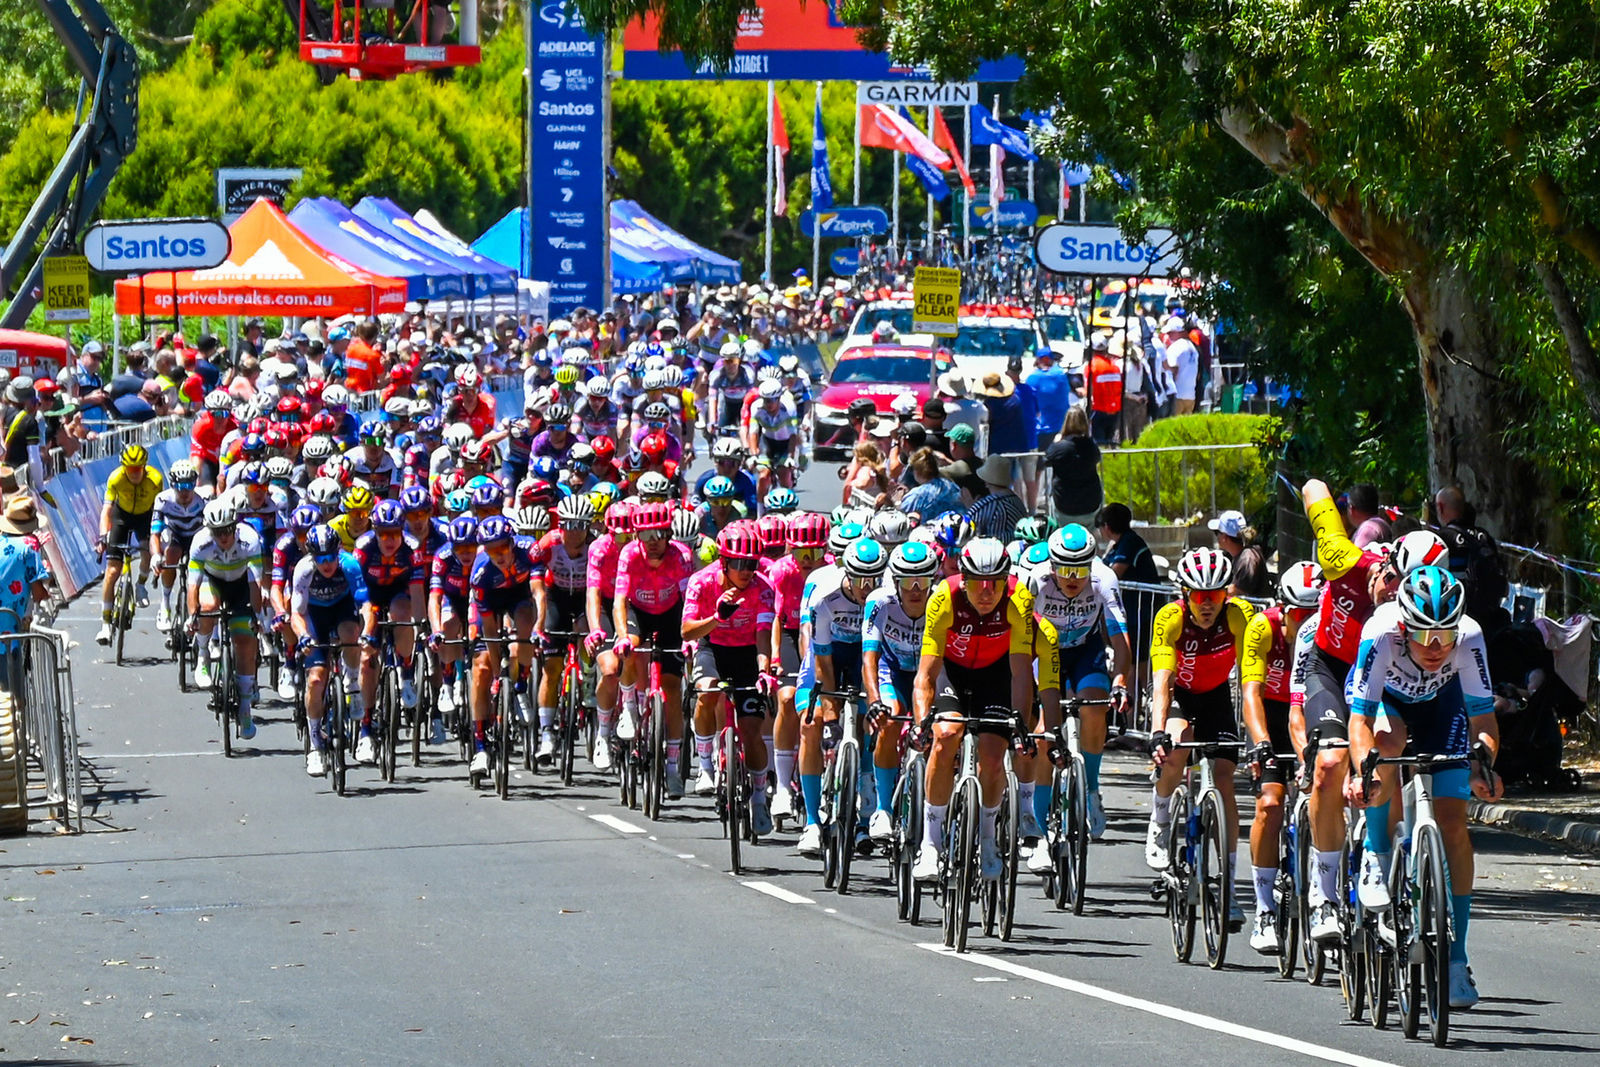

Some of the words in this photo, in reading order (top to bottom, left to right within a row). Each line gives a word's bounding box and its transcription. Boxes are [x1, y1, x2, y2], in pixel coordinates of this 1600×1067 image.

[539, 41, 596, 53] ADELAIDE
[734, 54, 762, 74] STAGE
[867, 85, 971, 102] GARMIN
[539, 101, 595, 116] Santos
[106, 235, 206, 260] Santos
[1060, 236, 1161, 263] Santos
[48, 284, 84, 297] KEEP
[154, 289, 334, 308] sportivebreaks.com.au
[920, 292, 953, 305] KEEP
[48, 295, 85, 308] CLEAR
[915, 304, 955, 318] CLEAR
[1316, 526, 1350, 569] Cofidis
[1044, 603, 1097, 616] BAHRAIN
[832, 615, 863, 628] BAHR
[884, 623, 920, 642] BAHR
[1244, 622, 1267, 668] Cofidis
[1471, 647, 1492, 691] MERIDA
